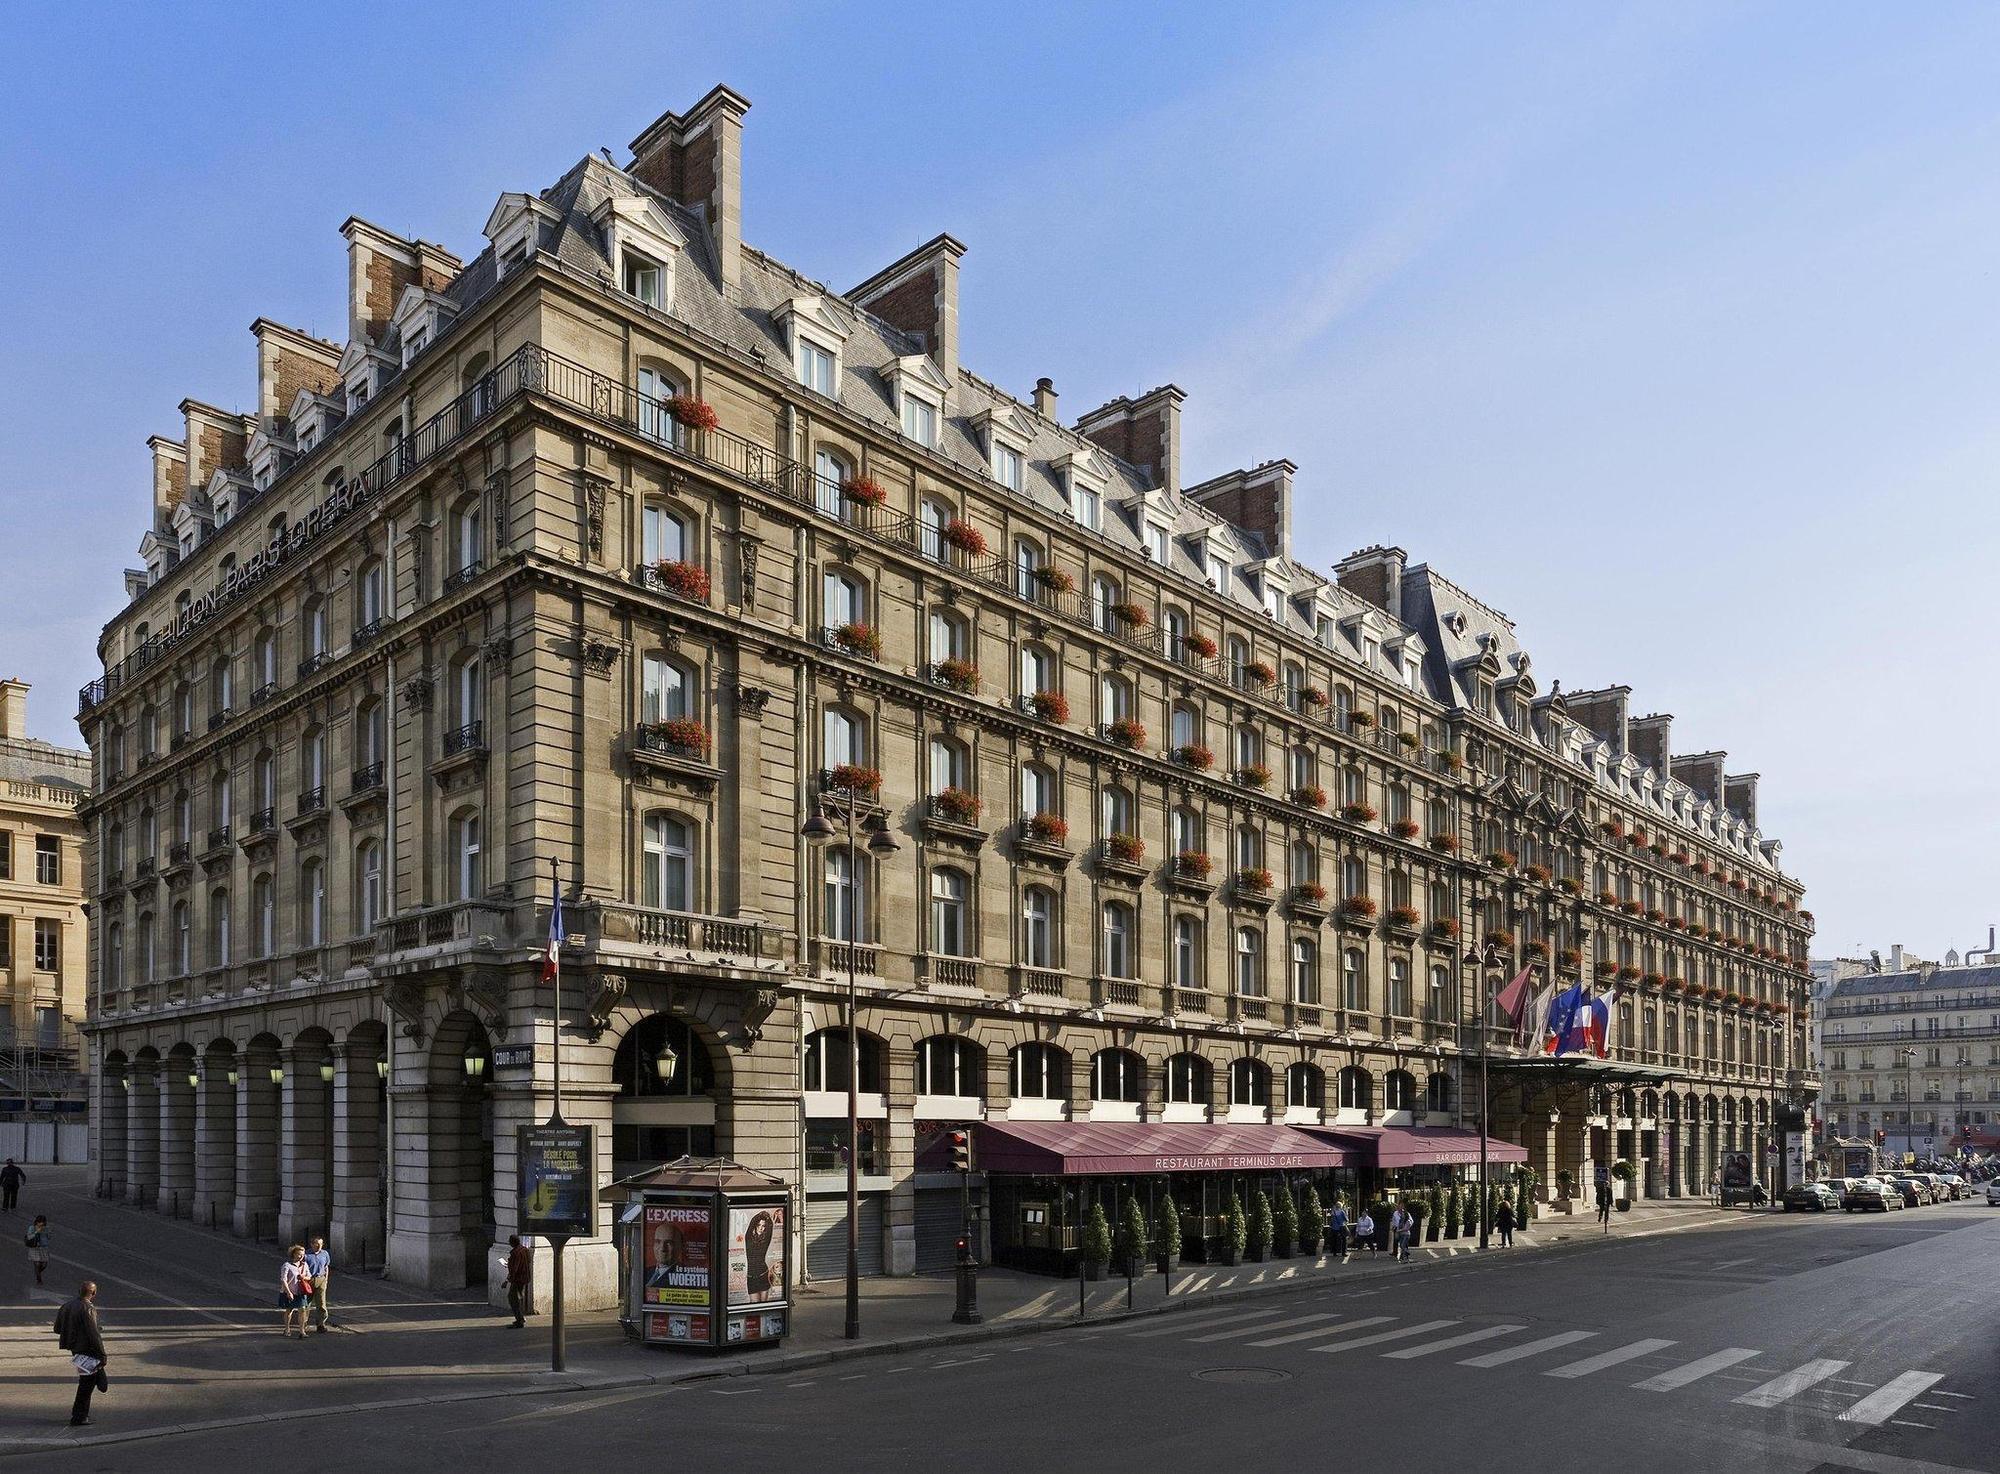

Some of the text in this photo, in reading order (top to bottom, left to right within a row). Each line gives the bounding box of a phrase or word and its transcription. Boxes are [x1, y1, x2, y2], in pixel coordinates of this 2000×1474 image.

[225, 538, 280, 593] PARIS
[495, 1052, 510, 1065] COUR
[516, 1050, 531, 1063] ROME
[1155, 1156, 1303, 1168] RESTAURANT TERMINUS CAFE
[1435, 1153, 1449, 1162] BAR
[1451, 1153, 1477, 1161] GOLDEN
[646, 1208, 709, 1222] L'EXPRESS
[675, 1265, 683, 1273] Le
[668, 1272, 709, 1287] WOERTH
